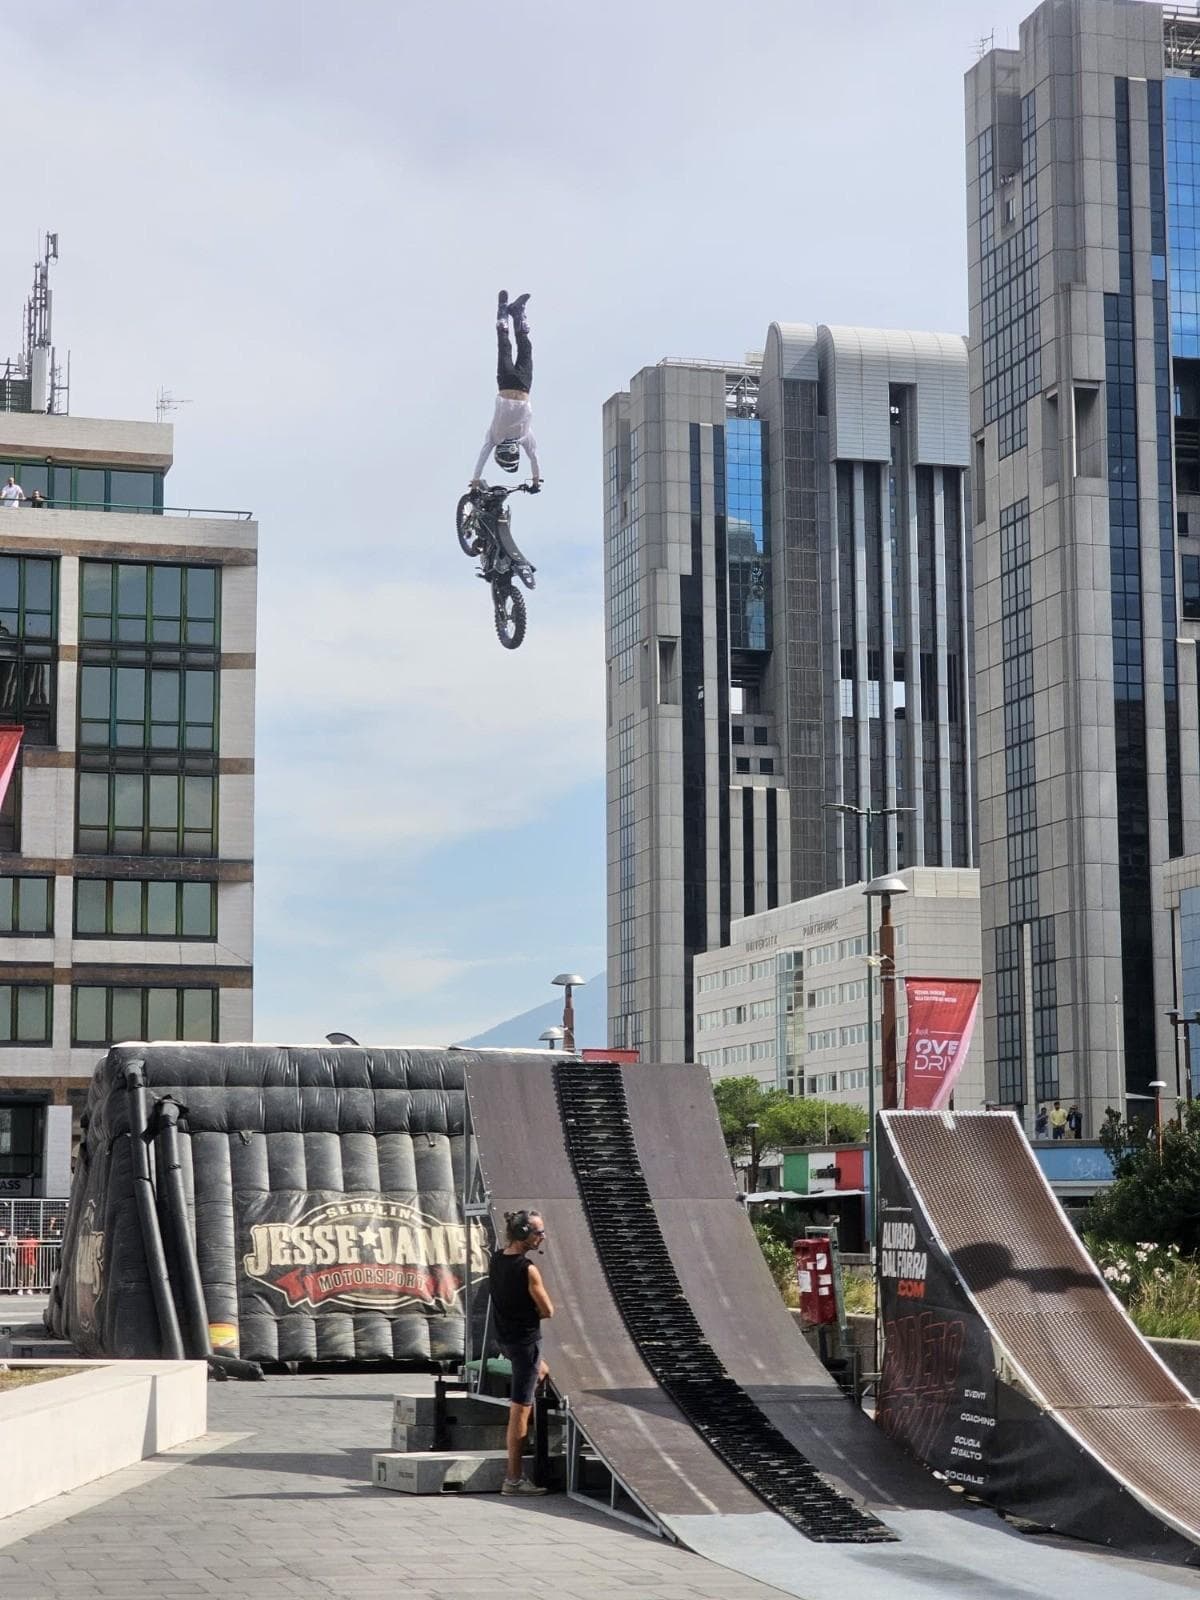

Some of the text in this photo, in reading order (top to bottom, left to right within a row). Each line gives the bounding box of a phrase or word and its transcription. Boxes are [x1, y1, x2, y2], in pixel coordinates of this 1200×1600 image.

[882, 1222, 916, 1250] ALVARO
[244, 1224, 489, 1276] JESSE JAMES
[882, 1250, 927, 1280] DAL FARRA
[318, 1268, 427, 1292] MOTORSPORT
[964, 1389, 986, 1400] EVENTI
[960, 1412, 996, 1427] COACHING
[954, 1435, 981, 1448] SCUOLA
[958, 1448, 983, 1461] SALTO
[945, 1470, 985, 1485] SOCIALE
